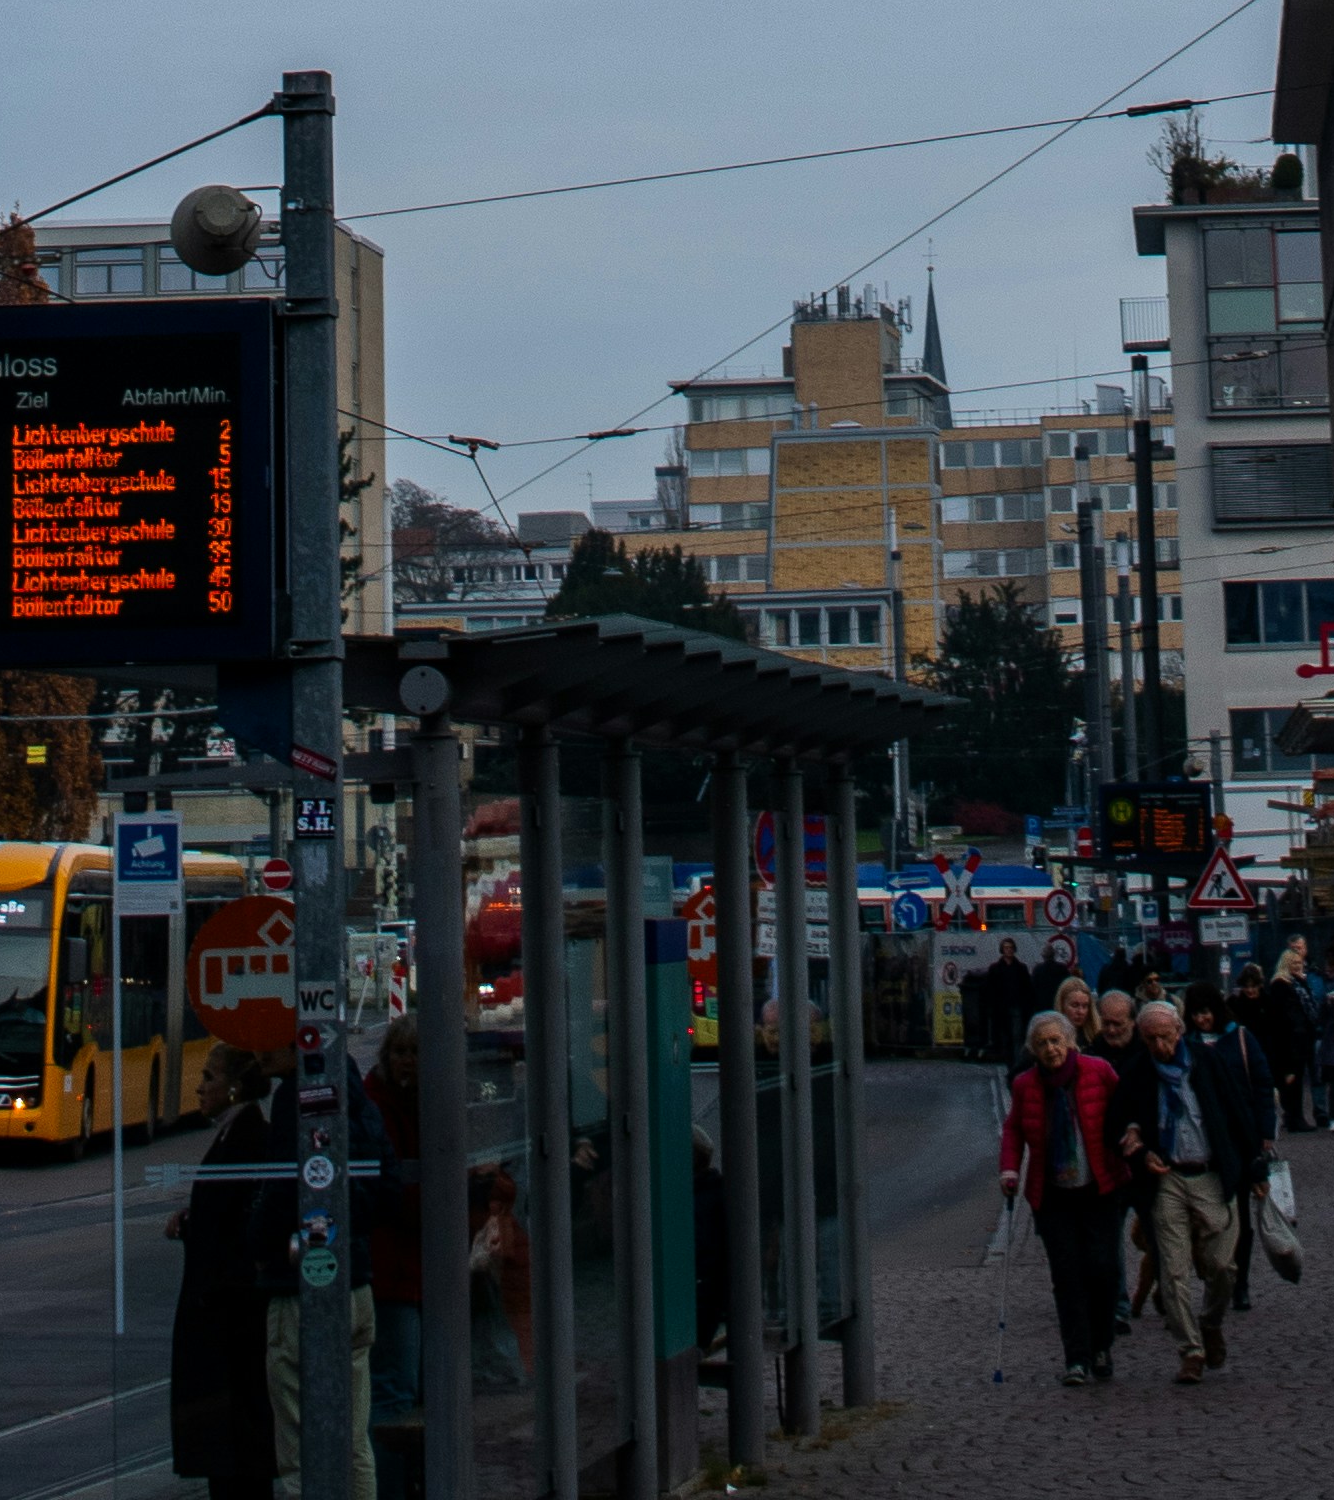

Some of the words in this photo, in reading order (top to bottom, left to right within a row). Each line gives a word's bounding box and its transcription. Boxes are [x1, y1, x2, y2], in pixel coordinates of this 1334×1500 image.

[16, 391, 49, 410] Ziel
[121, 385, 231, 407] Abfahrt/Min.
[11, 420, 176, 447] Lichtenbergschule
[220, 419, 232, 441] 2
[12, 447, 124, 471] Böllenfalltor
[220, 443, 232, 465] 5
[11, 469, 176, 495] Lichtenbergschule
[208, 467, 232, 489] 15
[12, 497, 123, 519] Böllenfalltor
[11, 518, 176, 544] Lichtenbergschule
[12, 546, 123, 569] Böllenfalltor
[11, 568, 176, 593] Lichtenbergschule
[12, 594, 124, 618] Böllenfalltor
[208, 590, 233, 614] 50
[297, 816, 336, 831] S.H.
[300, 989, 335, 1012] WC
